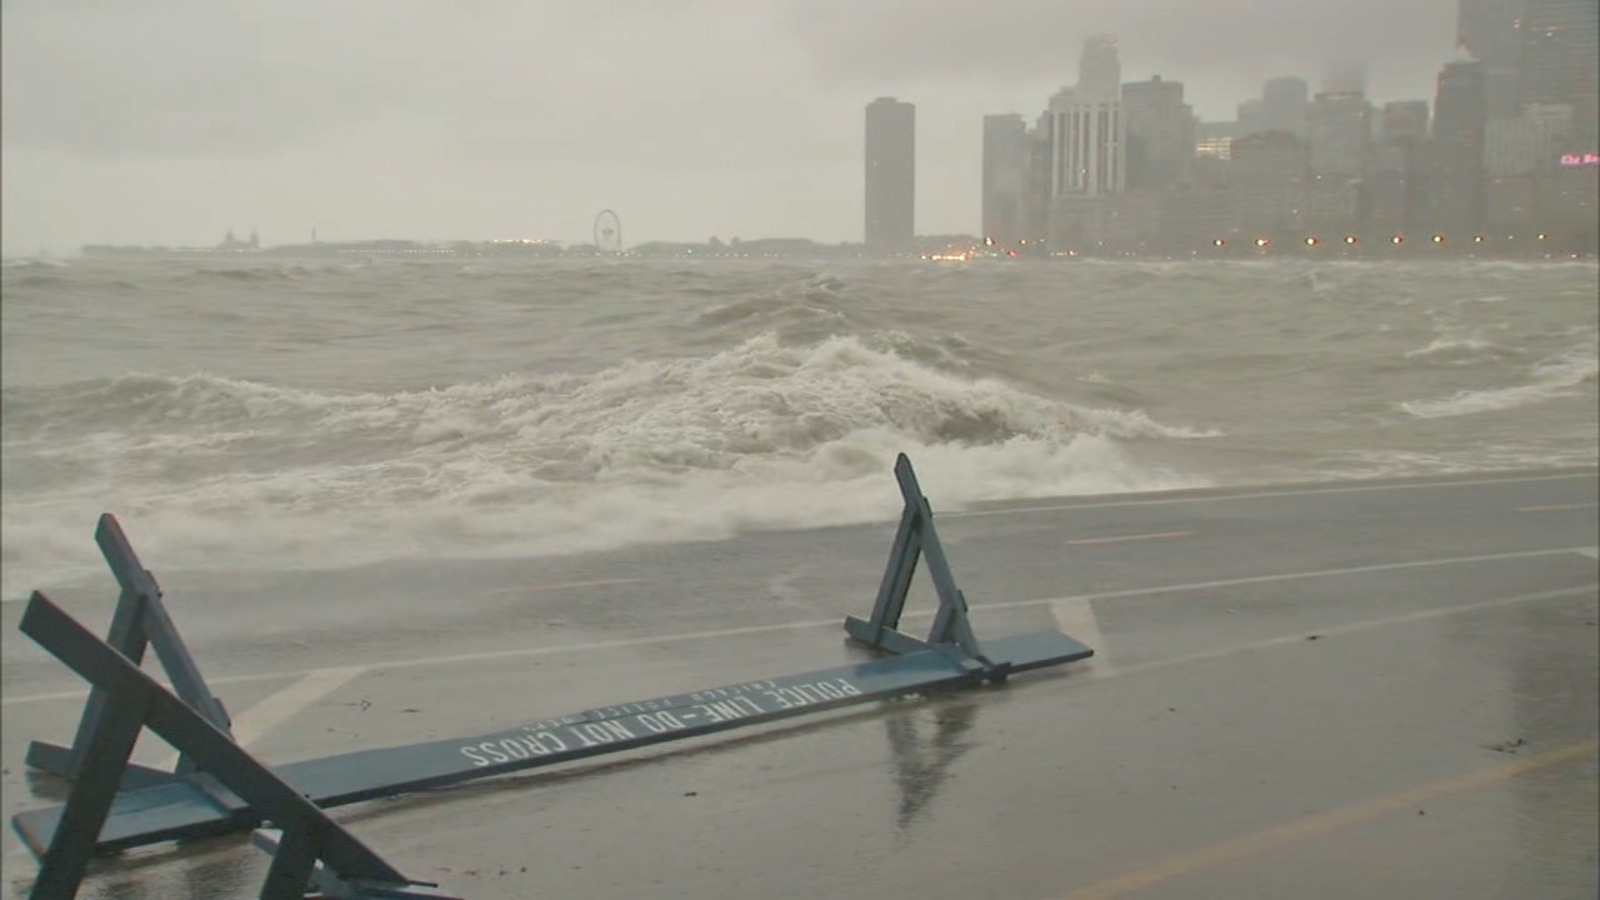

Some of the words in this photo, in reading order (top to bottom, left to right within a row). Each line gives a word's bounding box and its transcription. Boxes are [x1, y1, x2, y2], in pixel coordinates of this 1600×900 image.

[762, 678, 863, 709] POLICE
[570, 719, 636, 747] NOT
[460, 731, 568, 767] CROSS
